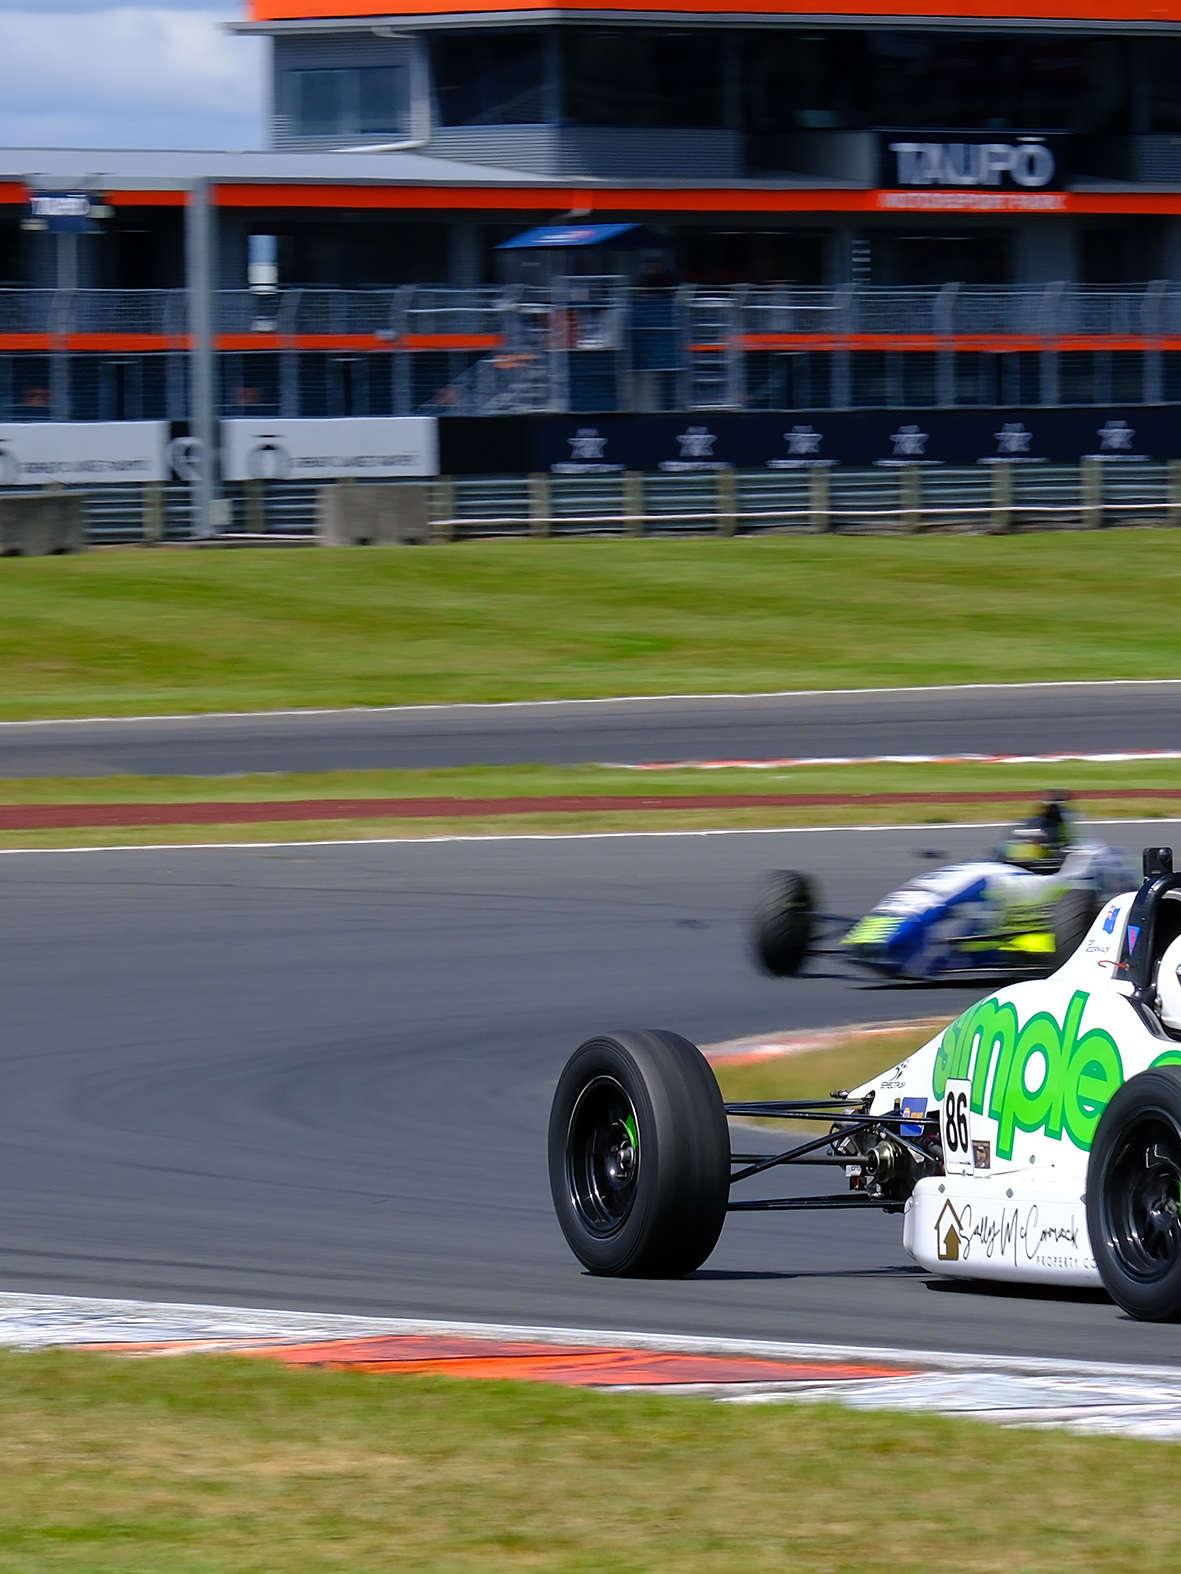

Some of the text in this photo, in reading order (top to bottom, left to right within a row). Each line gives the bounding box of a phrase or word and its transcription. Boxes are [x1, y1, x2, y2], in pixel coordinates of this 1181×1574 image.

[889, 136, 1056, 187] TAUPŌ
[945, 1091, 969, 1154] 86
[959, 1204, 1000, 1260] Sally
[1036, 1255, 1078, 1268] PROPERTY
